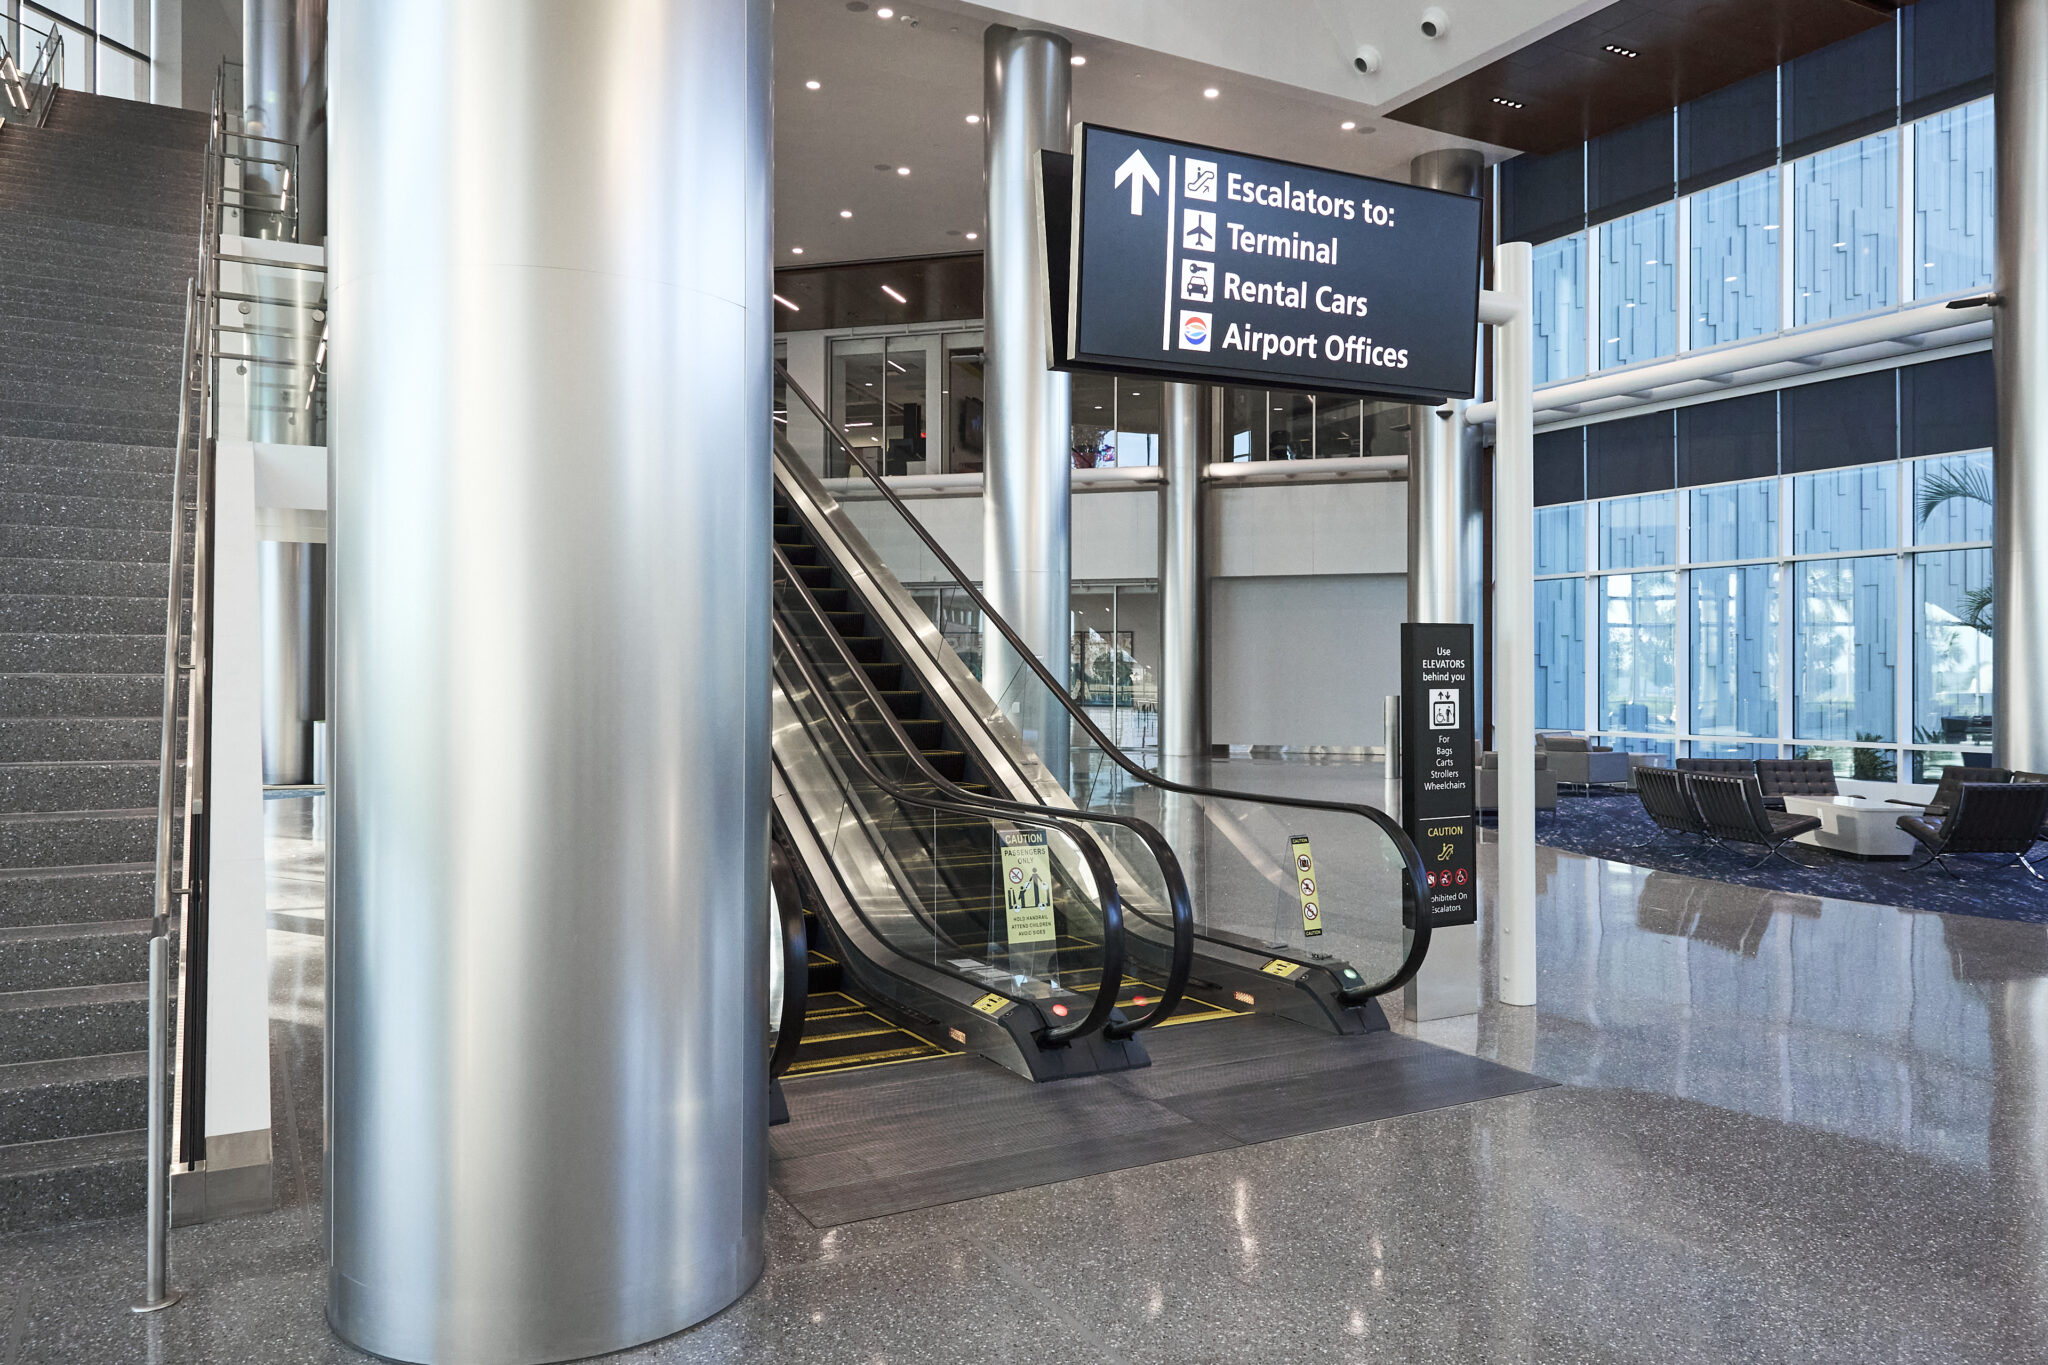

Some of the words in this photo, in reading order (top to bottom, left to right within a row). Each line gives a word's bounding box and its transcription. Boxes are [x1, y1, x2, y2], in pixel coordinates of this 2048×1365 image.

[1227, 172, 1356, 220] Escalators
[1361, 198, 1395, 228] to:
[1226, 221, 1338, 266] Terminal
[1223, 271, 1308, 310] Rental
[1315, 285, 1368, 317] Cars
[1221, 322, 1318, 361] Airport
[1324, 334, 1409, 369] Offices
[1436, 646, 1451, 656] Use
[1422, 659, 1465, 669] ELEVATORS
[1422, 671, 1449, 681] behind
[1450, 673, 1466, 684] you
[1438, 735, 1450, 744] For
[1436, 746, 1453, 757] Bags
[1435, 758, 1454, 767] Carts
[1430, 769, 1459, 779] Strollers
[1424, 781, 1466, 791] Wheelchairs
[1427, 826, 1463, 837] CAUTION
[1005, 833, 1043, 845] CAUTION
[1004, 848, 1046, 857] PASSENGERS
[1017, 857, 1034, 865] ONLY
[1457, 892, 1468, 900] On
